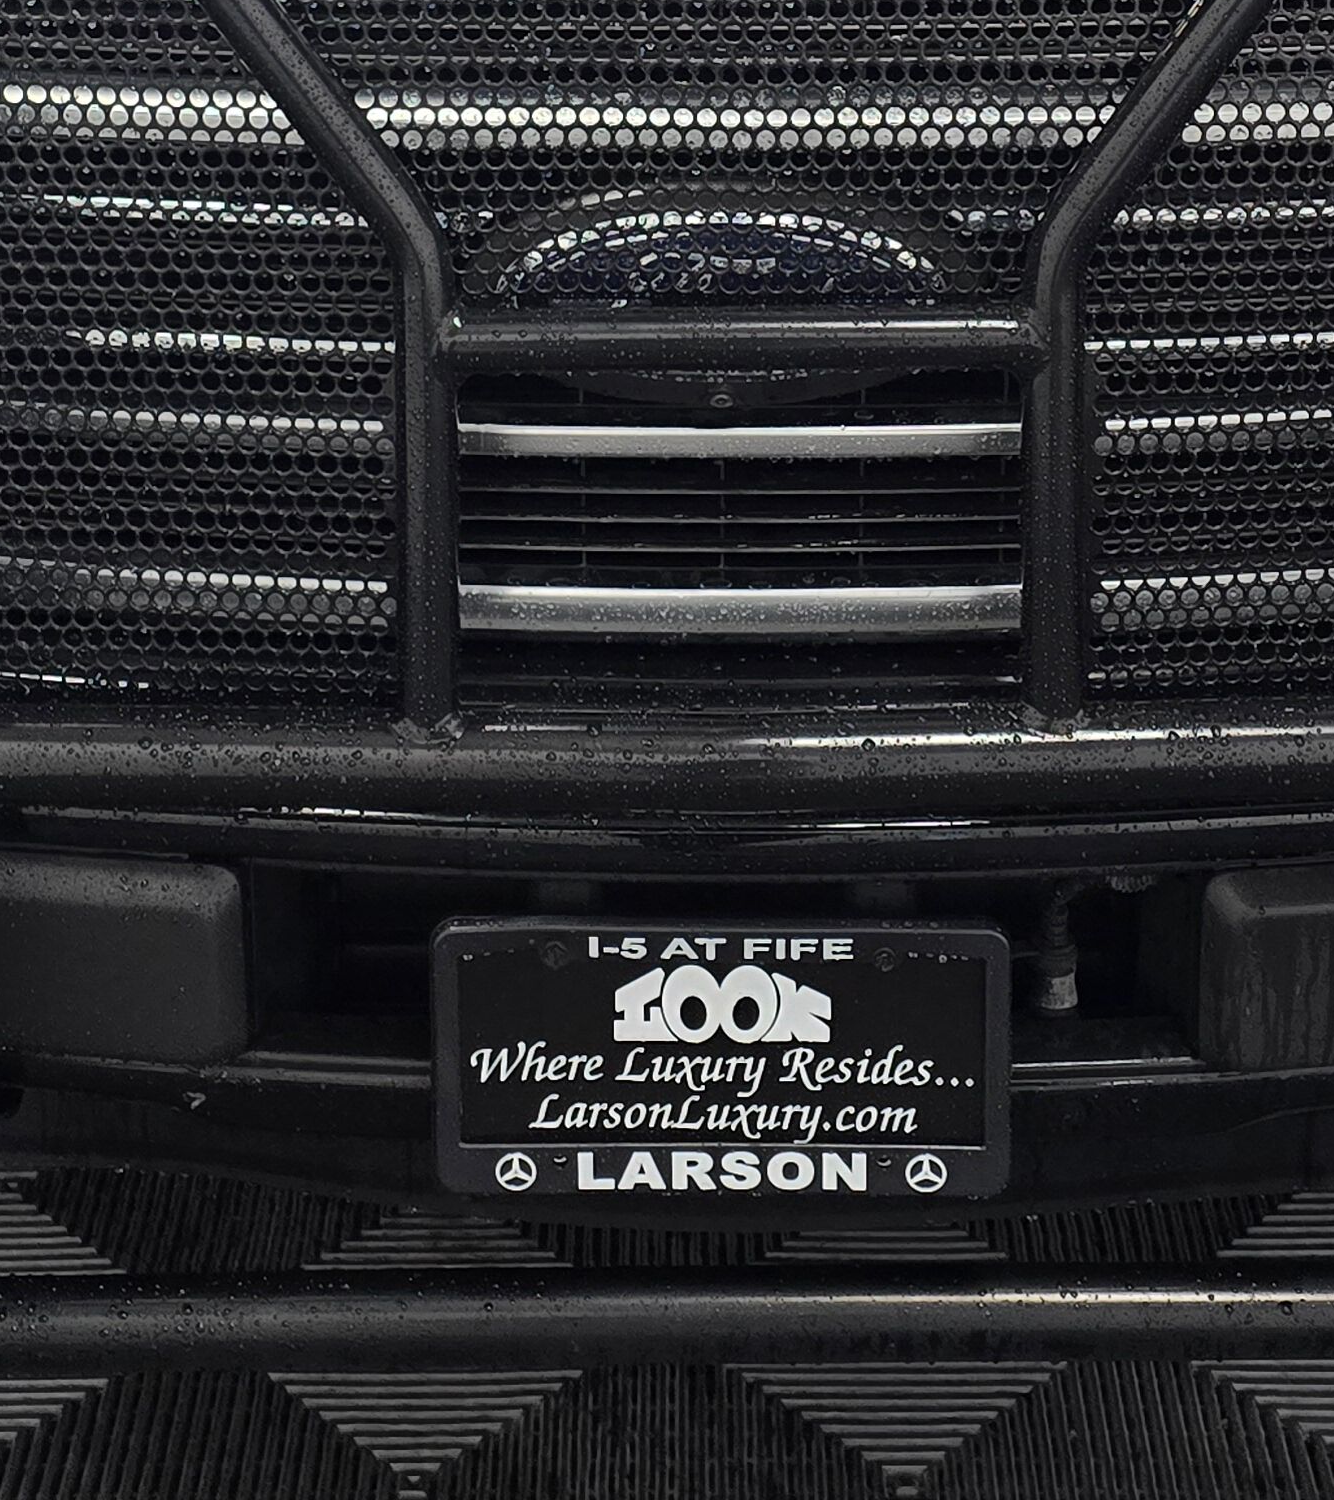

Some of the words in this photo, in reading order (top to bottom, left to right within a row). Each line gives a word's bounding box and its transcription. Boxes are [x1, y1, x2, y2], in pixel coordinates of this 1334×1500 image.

[587, 935, 649, 961] I-5
[659, 936, 728, 962] AT
[742, 937, 855, 962] FIFE
[469, 1040, 606, 1085] Where
[613, 1046, 768, 1098] Luxury
[776, 1044, 977, 1090] Resides...
[526, 1093, 920, 1145] LarsonLuxury.com
[576, 1149, 868, 1193] LARSON
